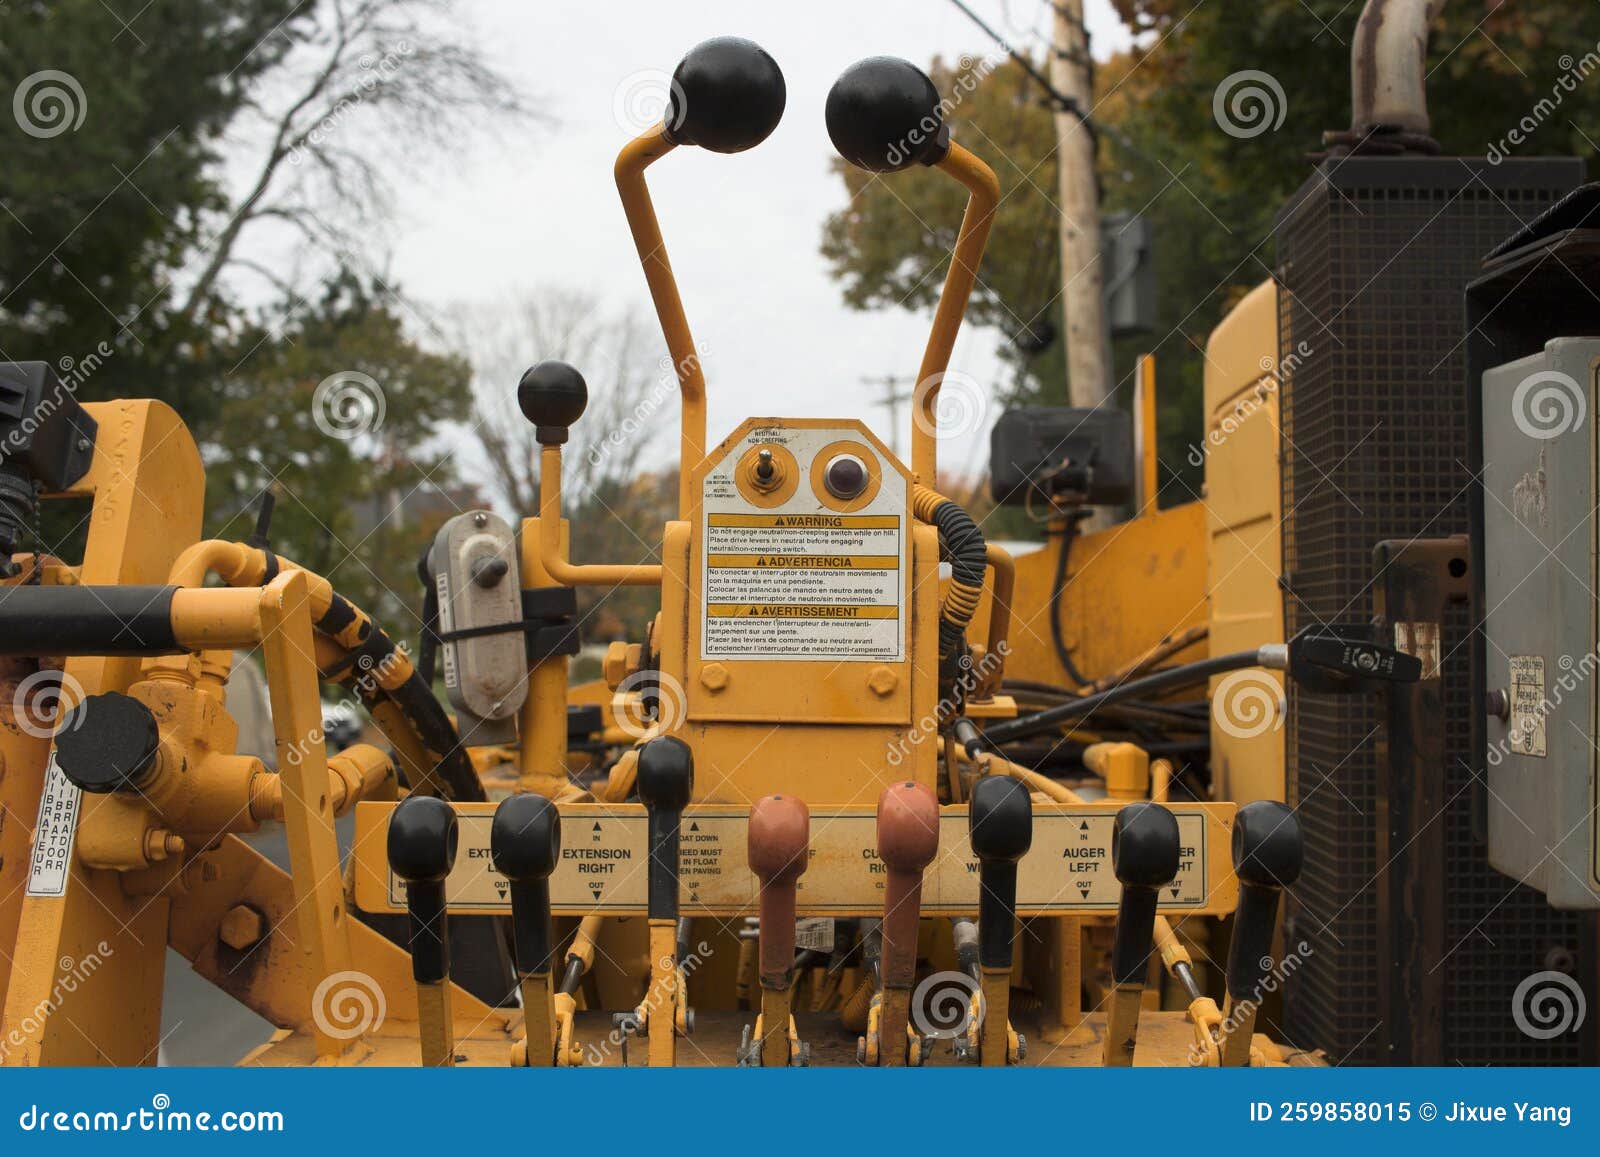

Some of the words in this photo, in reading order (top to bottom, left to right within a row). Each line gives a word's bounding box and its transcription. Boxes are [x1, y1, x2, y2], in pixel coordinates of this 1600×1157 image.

[786, 517, 842, 527] WARNING
[830, 538, 863, 546] engaging
[710, 545, 781, 553] neutral/non-creeping
[769, 558, 852, 567] ADVERTENCIA
[762, 607, 858, 617] AVERTISSEMENT
[34, 770, 58, 875] VIBRATEUR
[45, 777, 67, 870] VIBRATOR
[55, 787, 73, 871] IBRADOR
[592, 834, 601, 842] IN
[563, 848, 631, 860] EXTENSION
[1063, 848, 1105, 858] AUGER
[578, 863, 615, 874] RIGHT
[1069, 863, 1099, 872] LEFT
[494, 881, 509, 889] OUT
[589, 881, 604, 889] OUT
